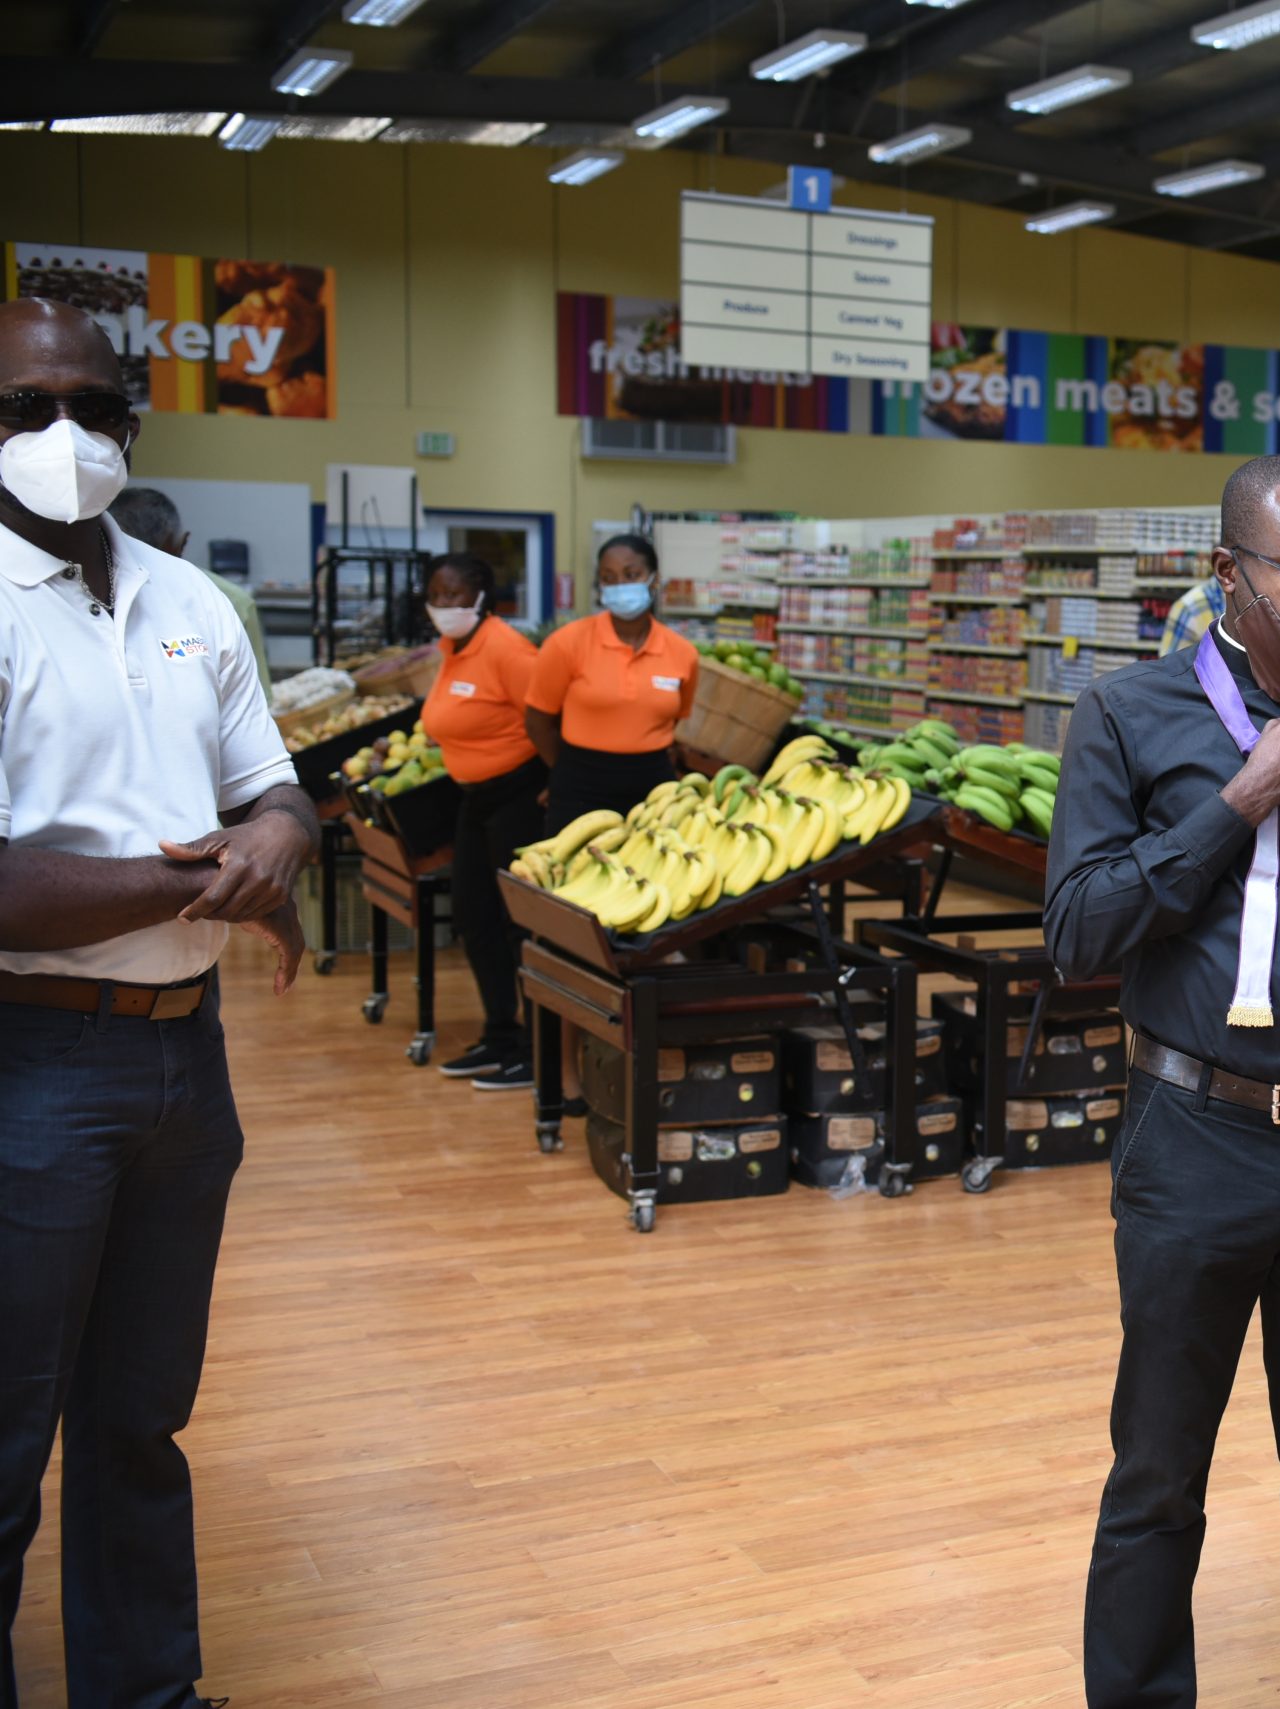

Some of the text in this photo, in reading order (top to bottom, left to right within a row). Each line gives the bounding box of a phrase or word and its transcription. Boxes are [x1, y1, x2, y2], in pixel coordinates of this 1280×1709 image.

[803, 176, 818, 203] 1
[724, 300, 769, 315] Produce
[838, 311, 880, 327] Canned
[94, 294, 285, 377] akery
[588, 339, 689, 379] fresh
[833, 352, 908, 370] Dry Seasoning
[1056, 378, 1198, 419] meats
[1210, 380, 1242, 420] &
